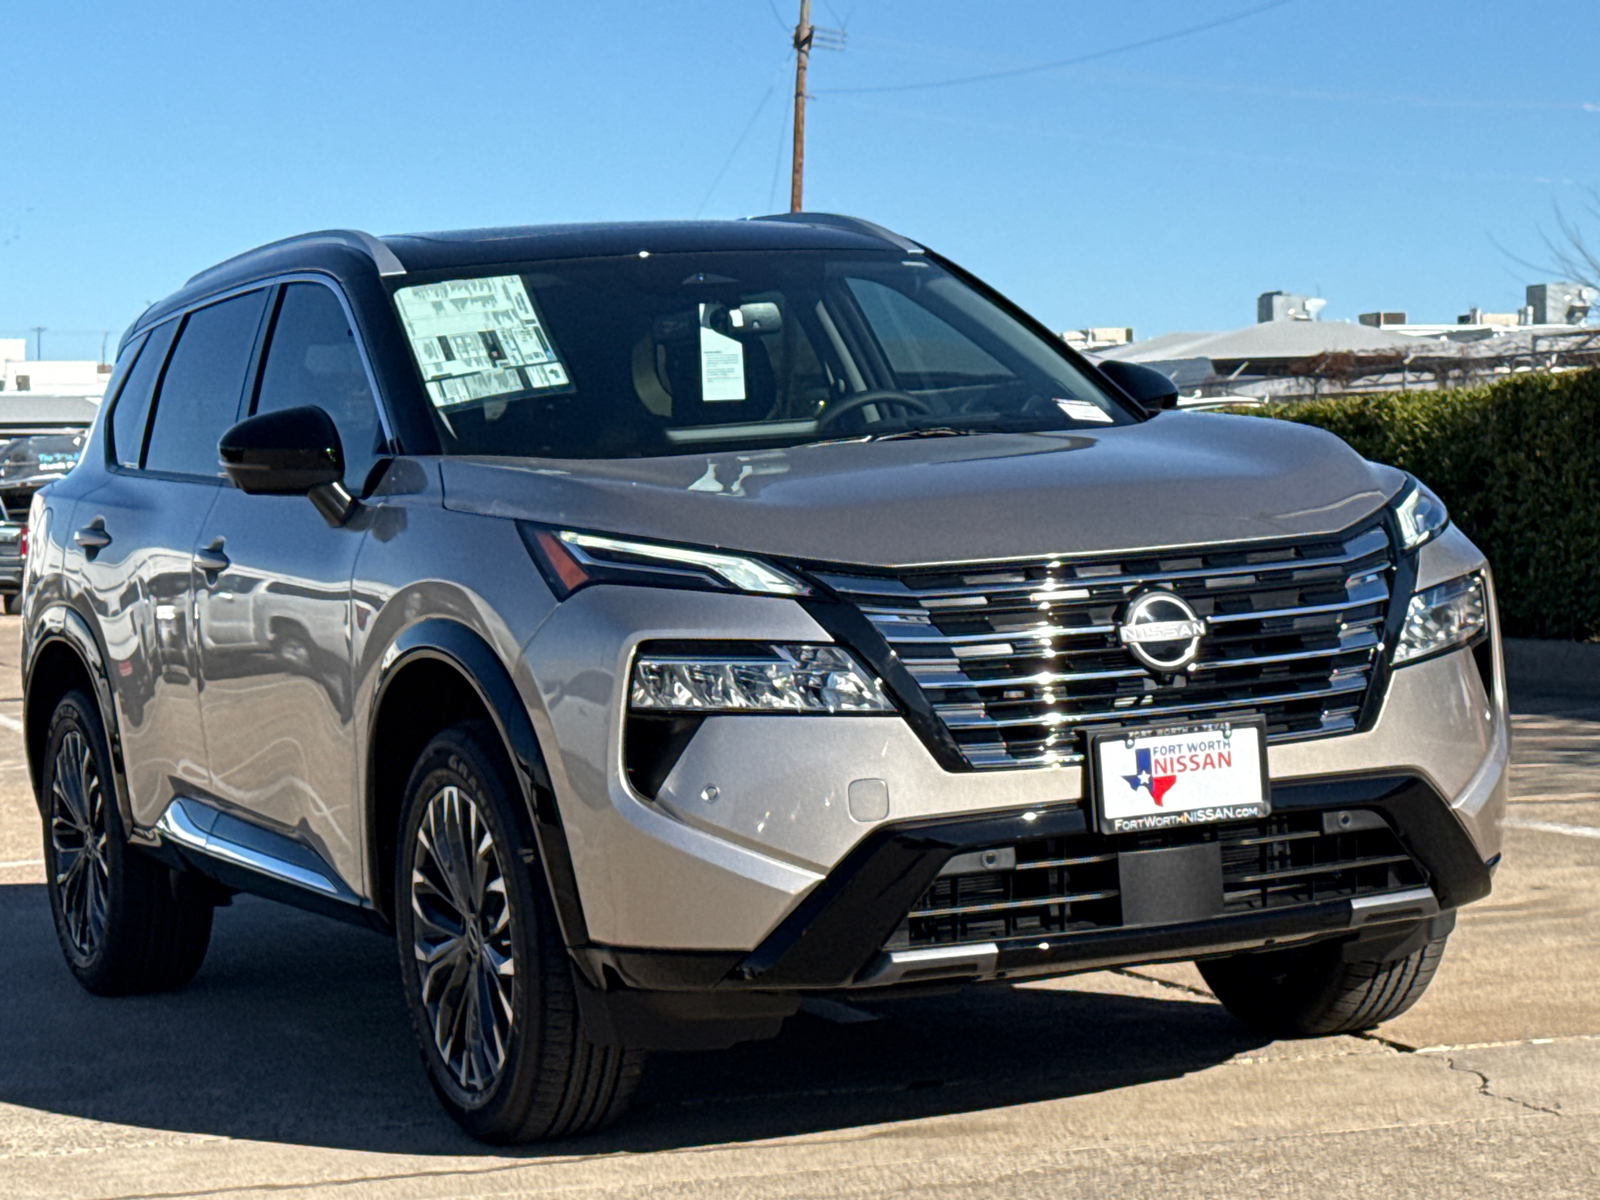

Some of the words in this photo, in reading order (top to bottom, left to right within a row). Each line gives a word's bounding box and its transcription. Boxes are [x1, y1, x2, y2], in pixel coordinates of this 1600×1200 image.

[1121, 621, 1206, 642] NISSAN
[1128, 730, 1153, 739] FORT
[1156, 727, 1188, 736] WORTH
[1202, 722, 1231, 732] TEXAS
[1153, 744, 1183, 757] FORT
[1187, 740, 1231, 754] WORTH
[1154, 750, 1232, 775] NISSAN
